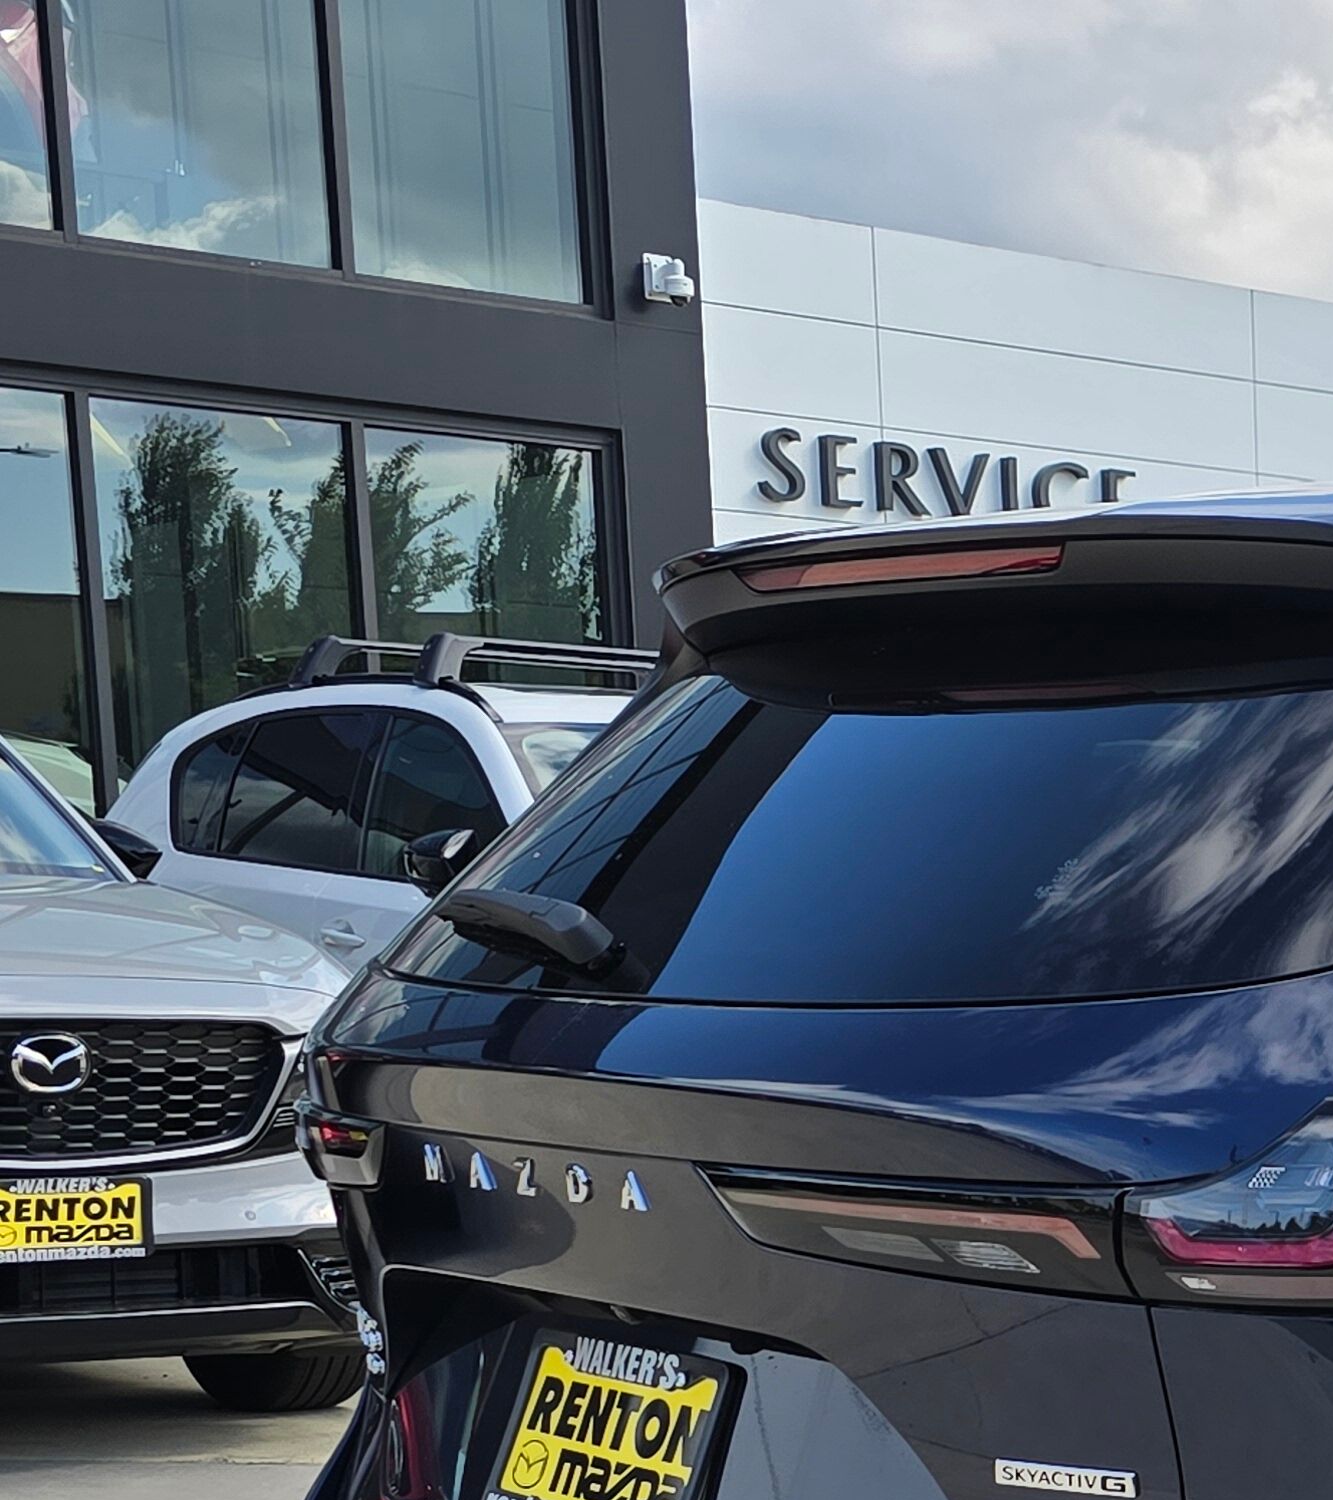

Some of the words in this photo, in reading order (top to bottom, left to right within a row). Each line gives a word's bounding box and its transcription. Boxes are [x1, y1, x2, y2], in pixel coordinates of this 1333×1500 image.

[16, 1177, 108, 1194] WALKER'S
[423, 1142, 650, 1212] MAZDA
[572, 1336, 681, 1390] WALKER'S
[526, 1375, 704, 1467] RENTON
